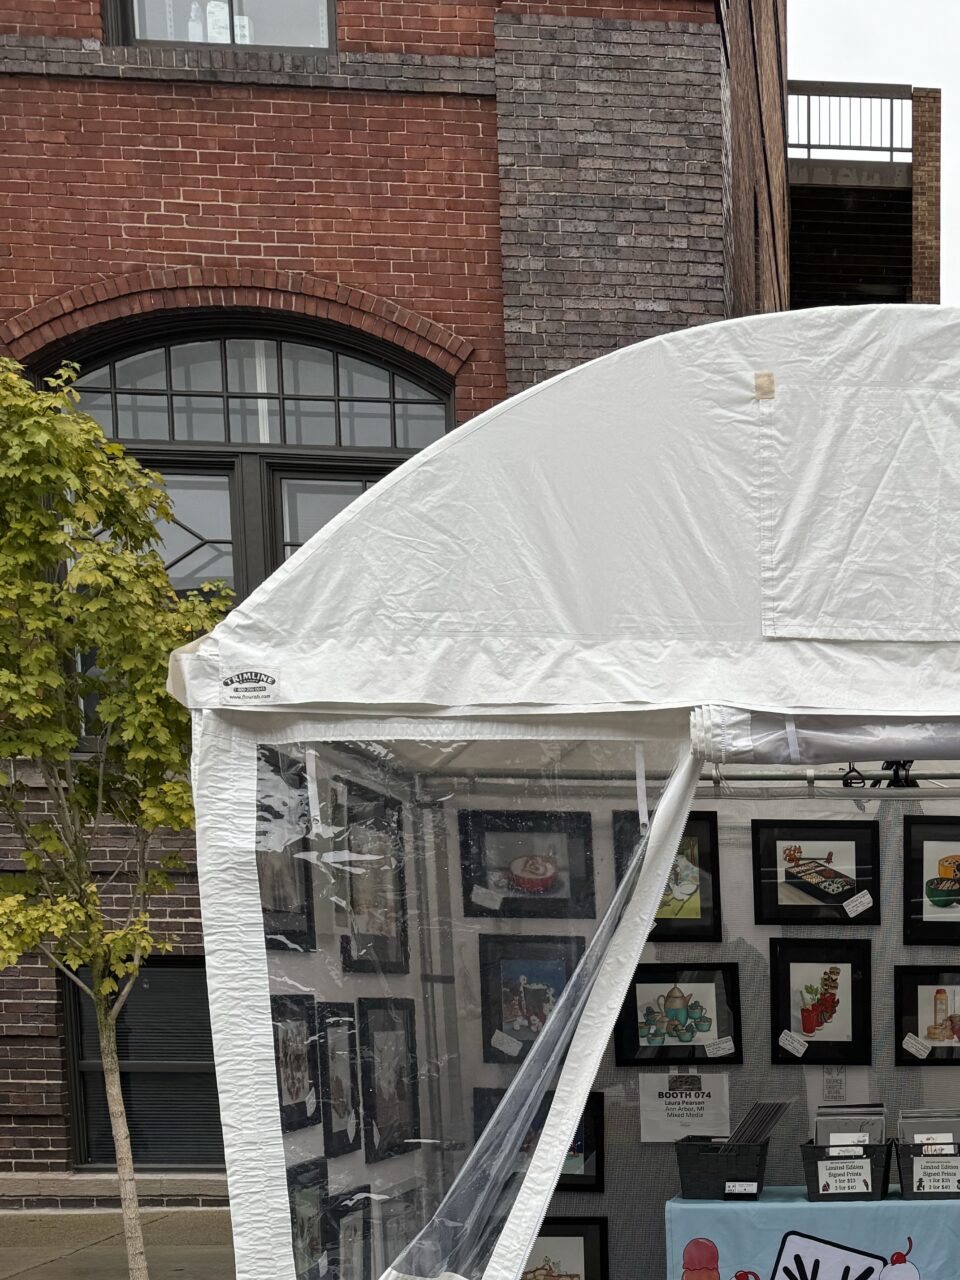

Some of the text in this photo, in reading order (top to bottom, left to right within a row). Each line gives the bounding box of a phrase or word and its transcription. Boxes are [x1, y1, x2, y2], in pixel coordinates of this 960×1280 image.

[225, 672, 274, 685] TRIMLINE
[658, 1091, 712, 1099] BOOTH 074
